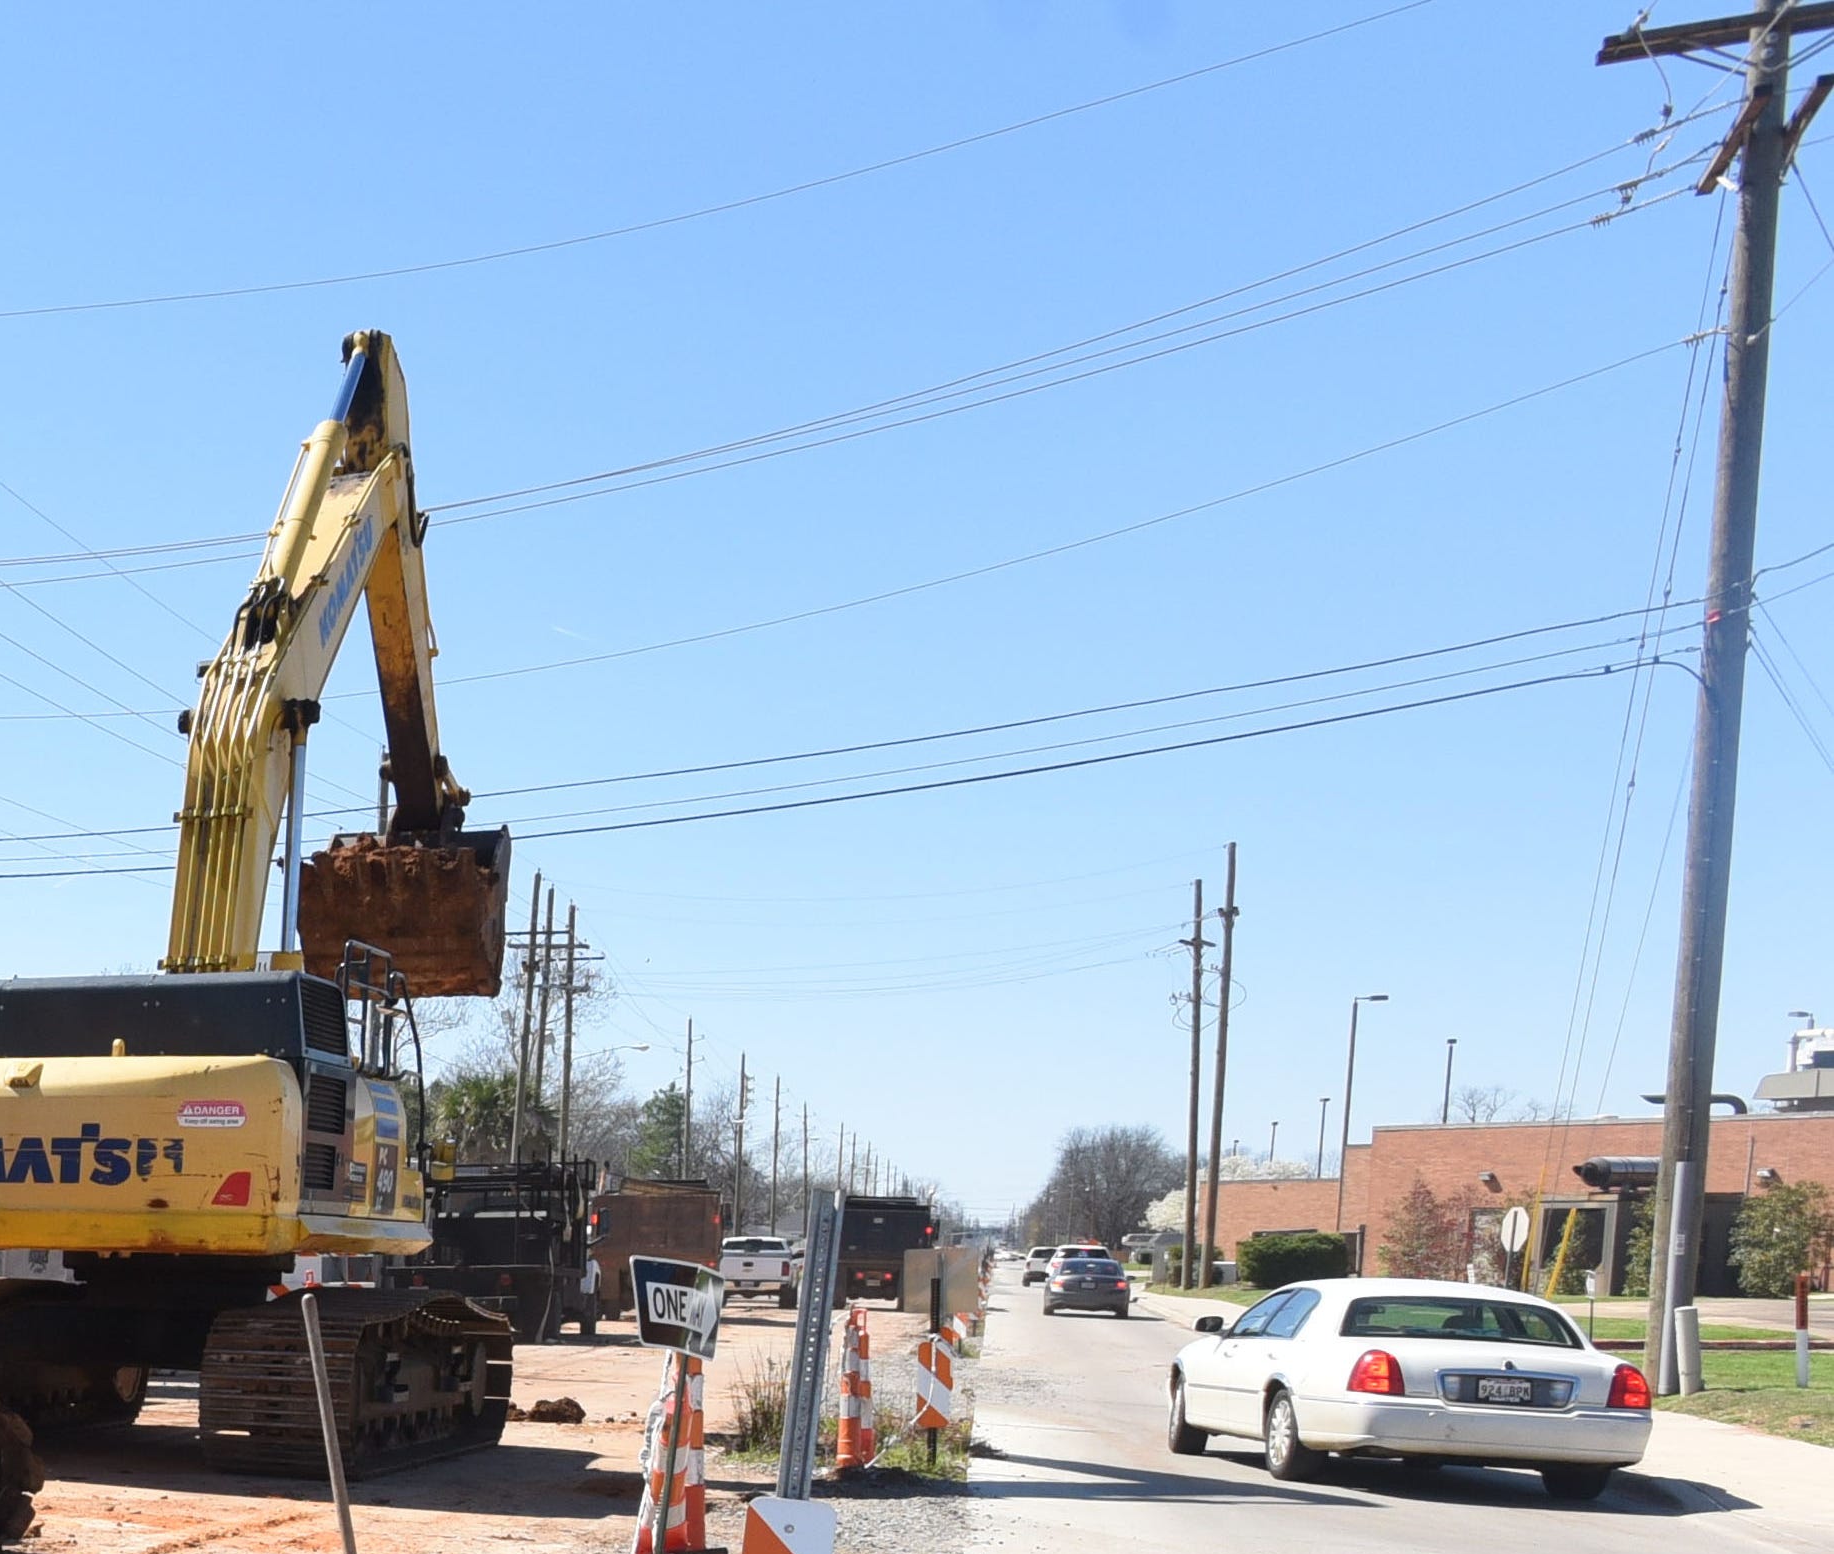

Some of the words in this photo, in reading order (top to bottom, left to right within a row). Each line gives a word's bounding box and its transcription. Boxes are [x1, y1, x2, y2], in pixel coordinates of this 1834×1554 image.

[319, 514, 372, 650] KOMATSU
[194, 1105, 240, 1115] DANGER
[376, 1167, 394, 1193] 490
[653, 1287, 687, 1322] ONE
